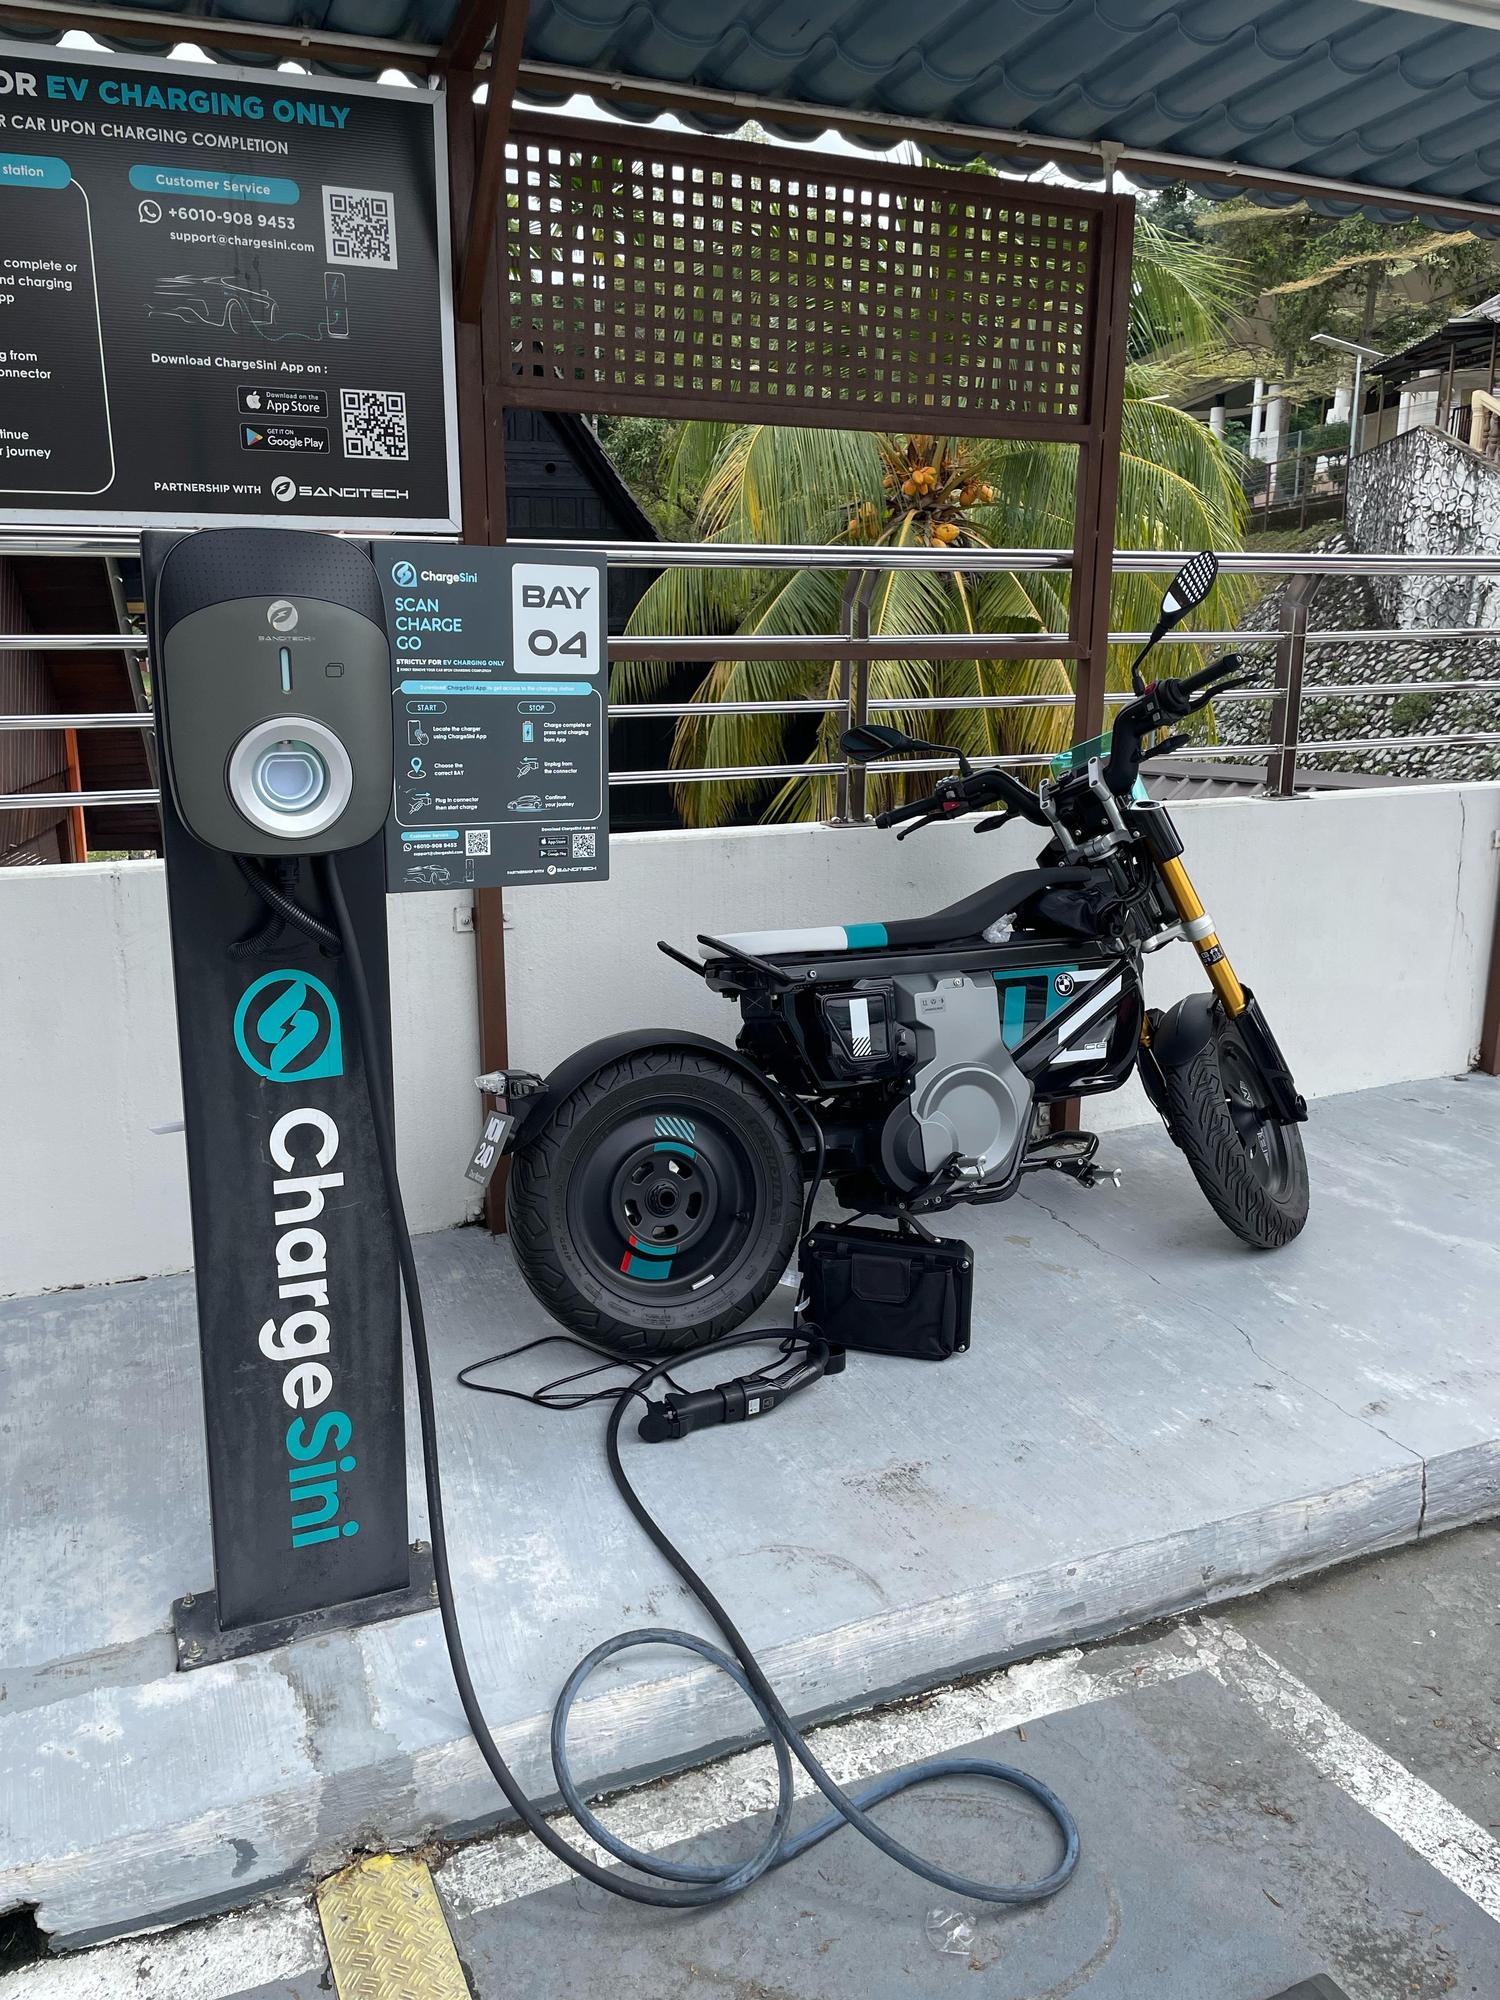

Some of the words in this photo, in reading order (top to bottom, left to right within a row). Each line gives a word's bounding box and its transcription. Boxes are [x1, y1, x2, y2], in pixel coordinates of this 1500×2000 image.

[47, 74, 89, 101] EV
[98, 80, 265, 120] CHARGING
[273, 99, 351, 129] ONLY
[11, 115, 46, 131] CAR
[51, 119, 96, 136] UPON
[100, 123, 188, 144] CHARGING
[192, 132, 289, 155] COMPLETION
[2, 164, 44, 177] station
[155, 174, 219, 190] Customer
[223, 180, 271, 195] Service
[168, 207, 253, 226] +6010-908
[257, 214, 296, 230] 9453
[169, 230, 315, 253] support@chargesini.com
[3, 259, 62, 272] complete
[65, 263, 78, 272] or
[18, 276, 73, 291] charging
[10, 349, 38, 361] from
[151, 353, 211, 367] Download
[214, 357, 277, 371] ChargeSini
[280, 361, 304, 374] App
[307, 364, 321, 374] on
[266, 391, 297, 400] Download
[266, 399, 290, 413] App
[291, 400, 320, 413] Store
[267, 435, 303, 449] Google
[304, 436, 324, 450] Play
[6, 445, 51, 460] journey
[154, 481, 230, 494] PARTNERSHIP
[232, 484, 262, 495] WITH
[299, 486, 409, 500] SANGITECH
[420, 570, 478, 585] ChargeSini
[522, 584, 591, 610] BAY
[394, 597, 439, 613] SCAN
[395, 616, 462, 632] CHARGE
[396, 635, 422, 651] GO
[527, 629, 588, 659] 04
[396, 658, 427, 666] STRICTLY
[428, 658, 442, 666] FOR
[453, 659, 487, 667] CHARGING
[258, 1107, 360, 1549] ChargeSini
